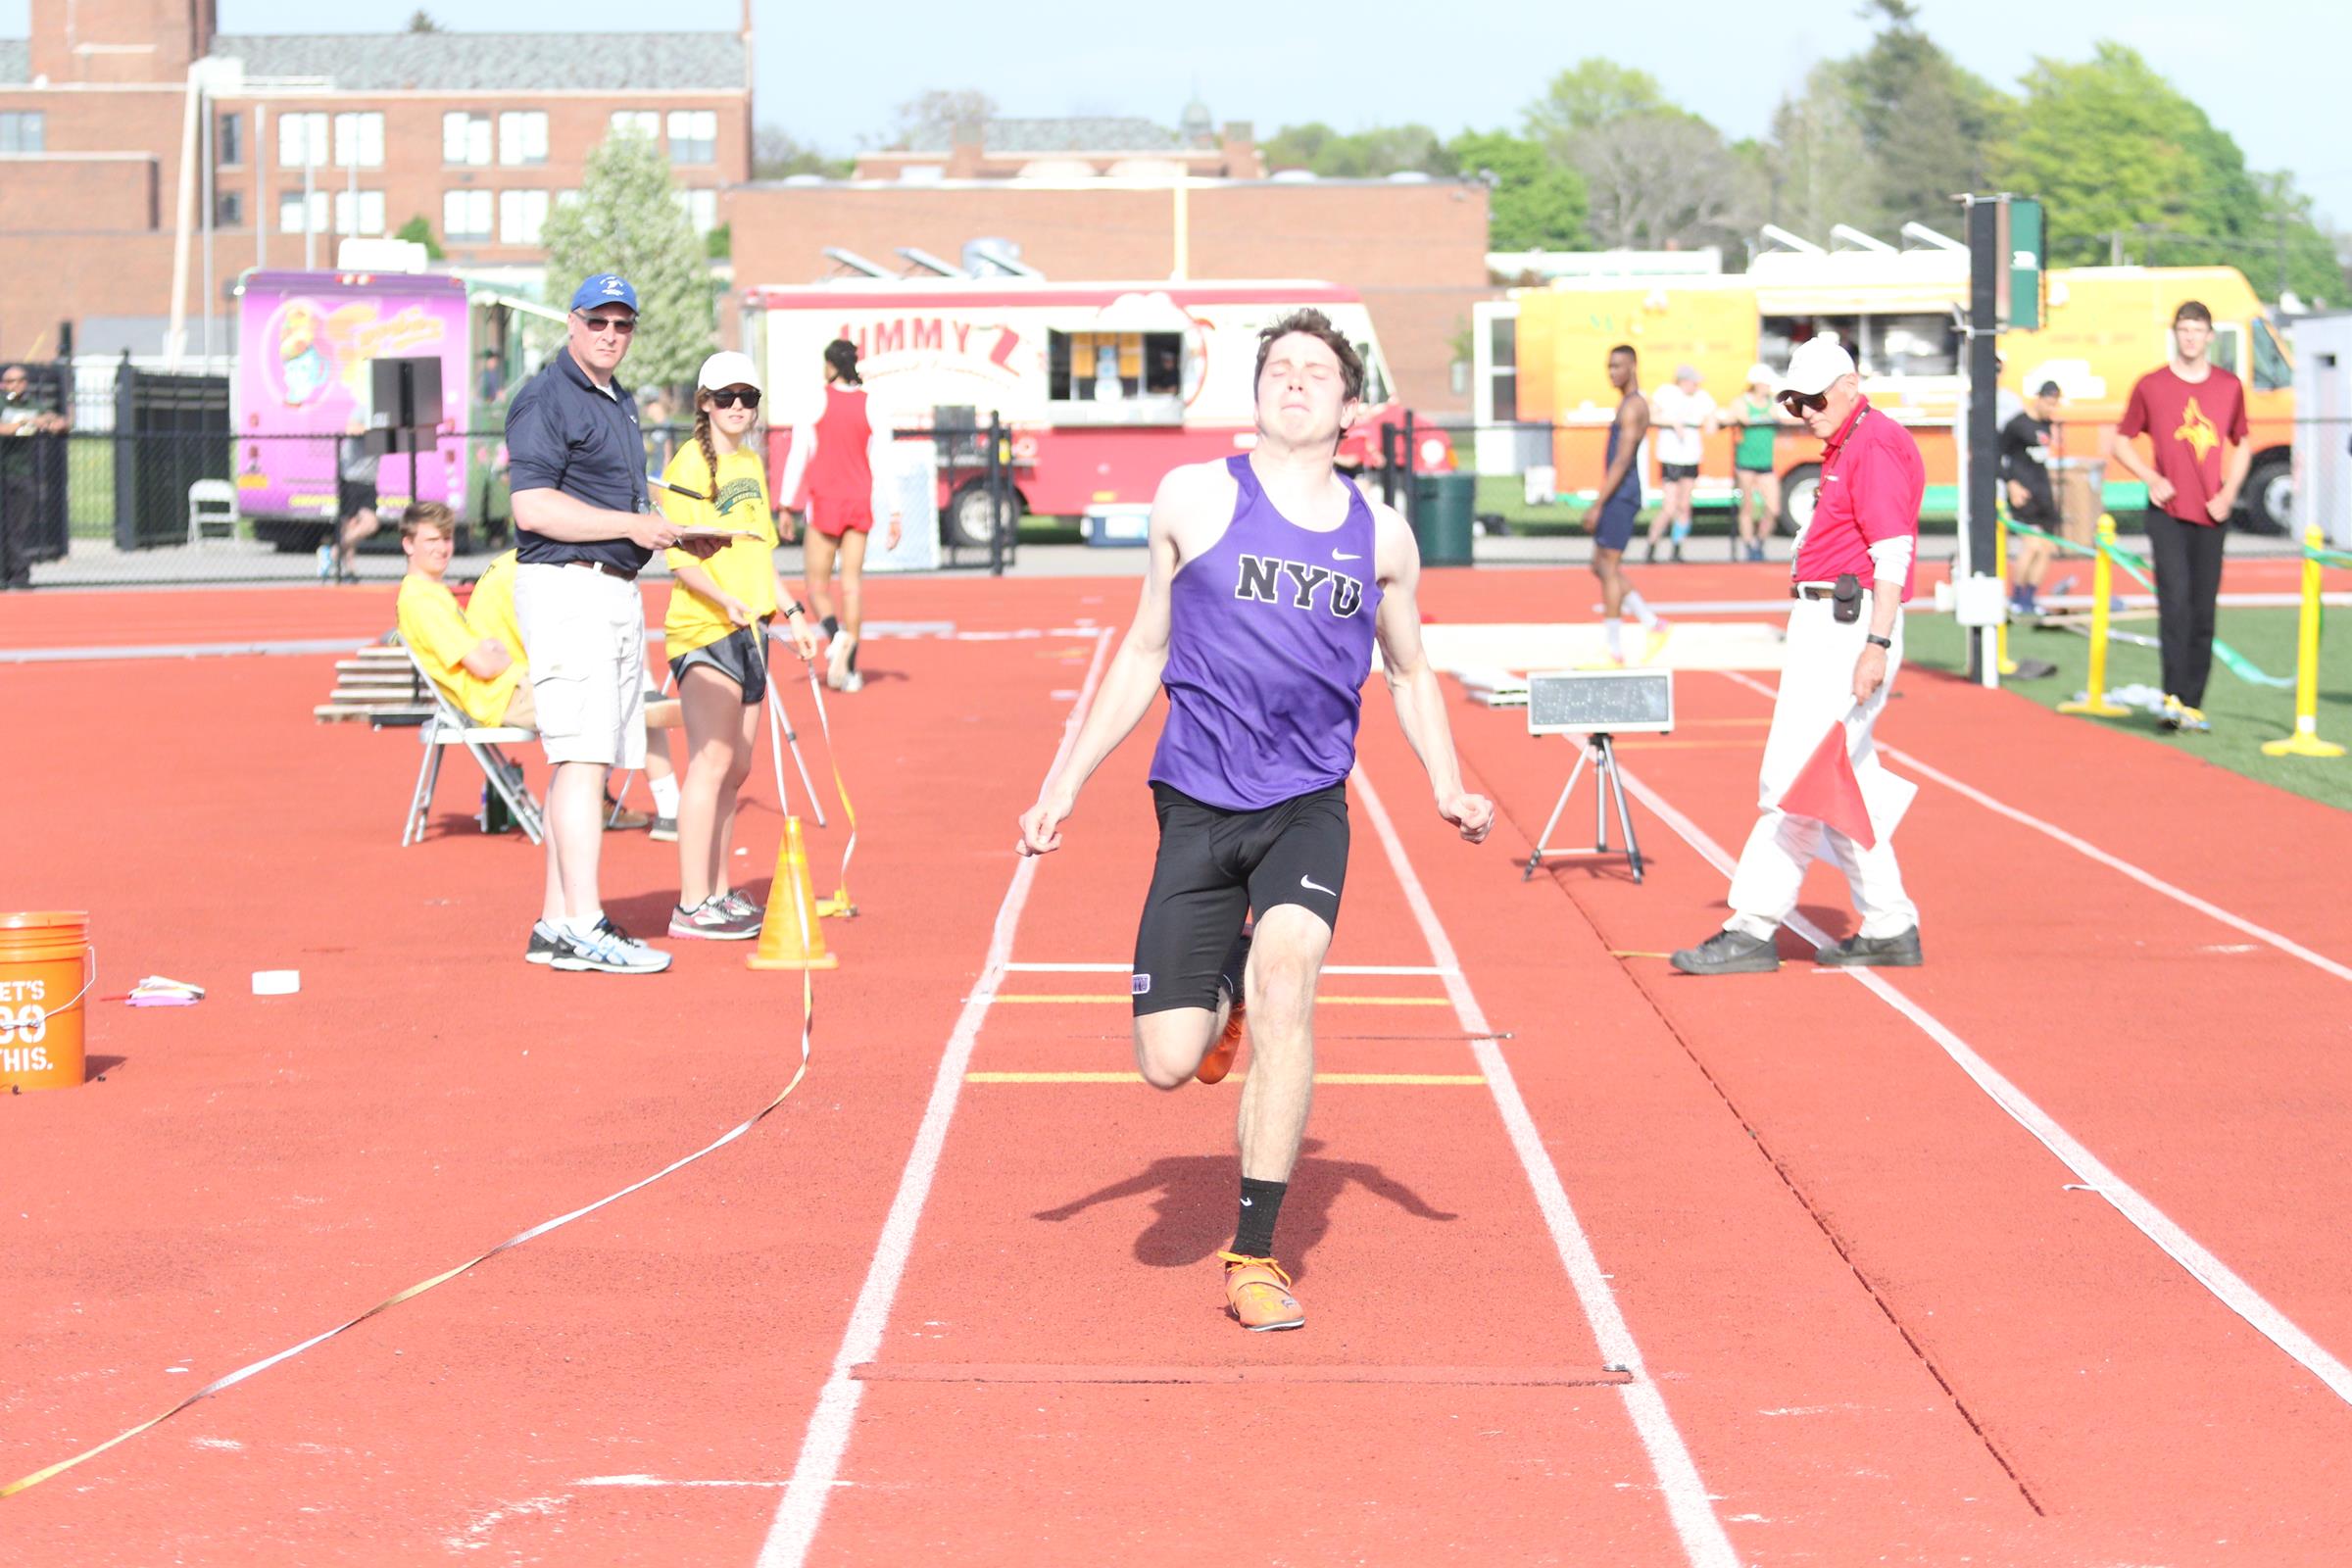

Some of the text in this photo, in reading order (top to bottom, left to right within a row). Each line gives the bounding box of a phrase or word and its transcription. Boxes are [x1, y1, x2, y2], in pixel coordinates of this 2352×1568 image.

[1235, 554, 1362, 618] NYU
[0, 979, 46, 1002] ET'S
[0, 1046, 55, 1073] HIS.
